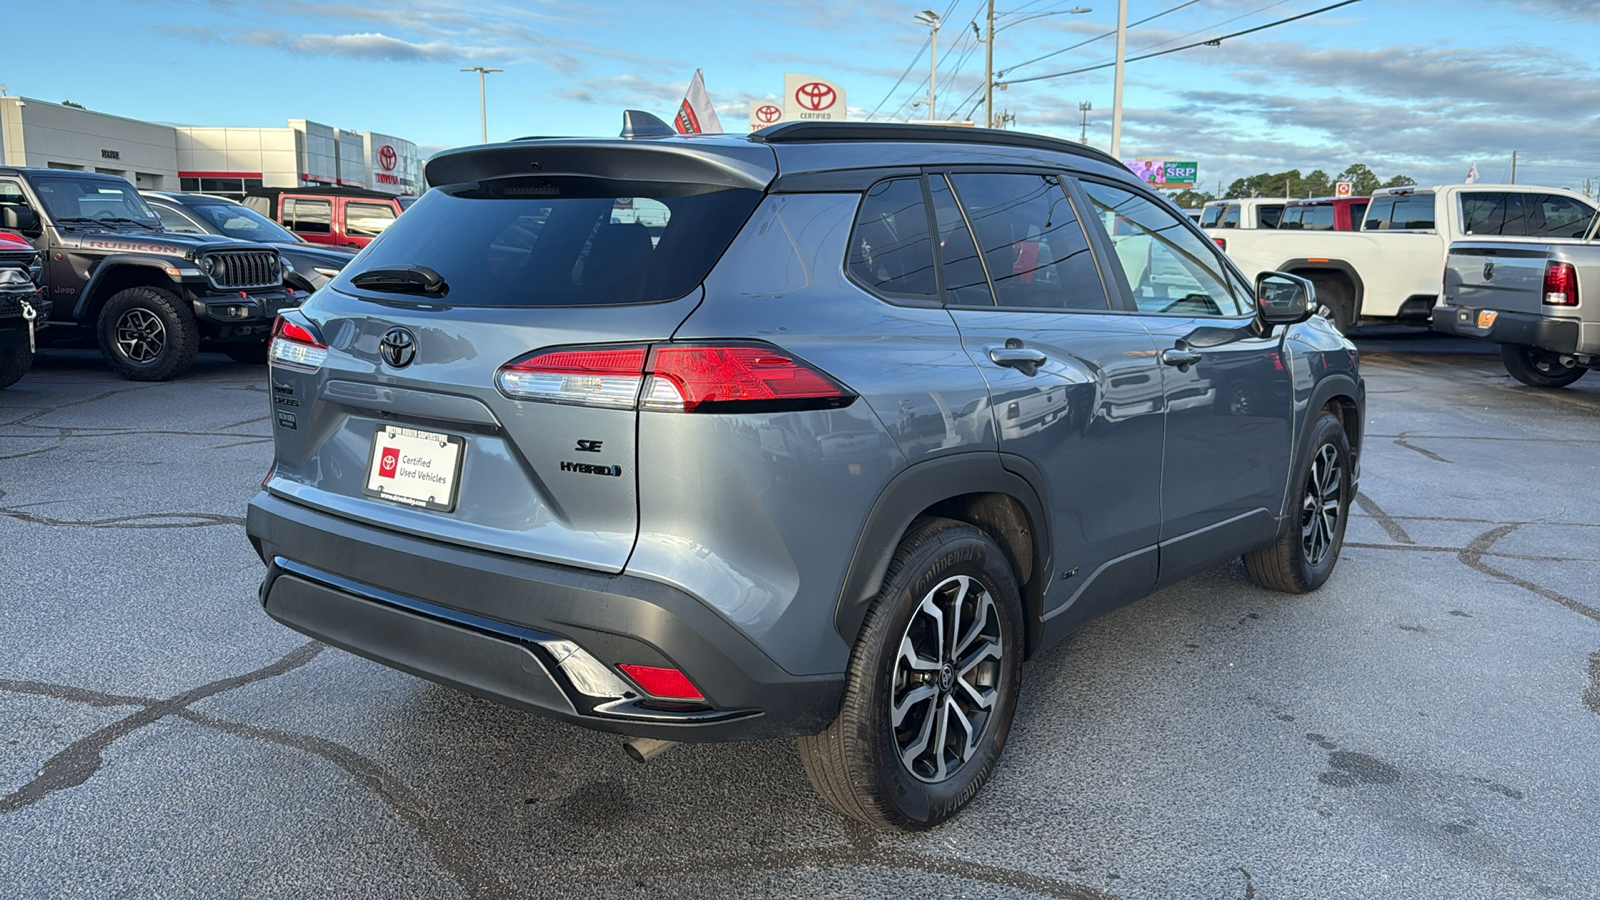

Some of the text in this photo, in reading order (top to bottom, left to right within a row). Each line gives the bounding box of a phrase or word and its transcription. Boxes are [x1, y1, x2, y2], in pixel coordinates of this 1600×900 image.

[800, 112, 831, 120] CERTIFIED
[1166, 168, 1195, 176] SRP
[375, 173, 399, 185] TOYOTA
[89, 241, 179, 253] RUBICON
[55, 286, 75, 295] Jeep
[575, 439, 603, 452] SE
[402, 455, 431, 468] Certified
[560, 461, 612, 476] HYBRID
[399, 467, 447, 484] Used Vehicles
[915, 548, 974, 594] Continental
